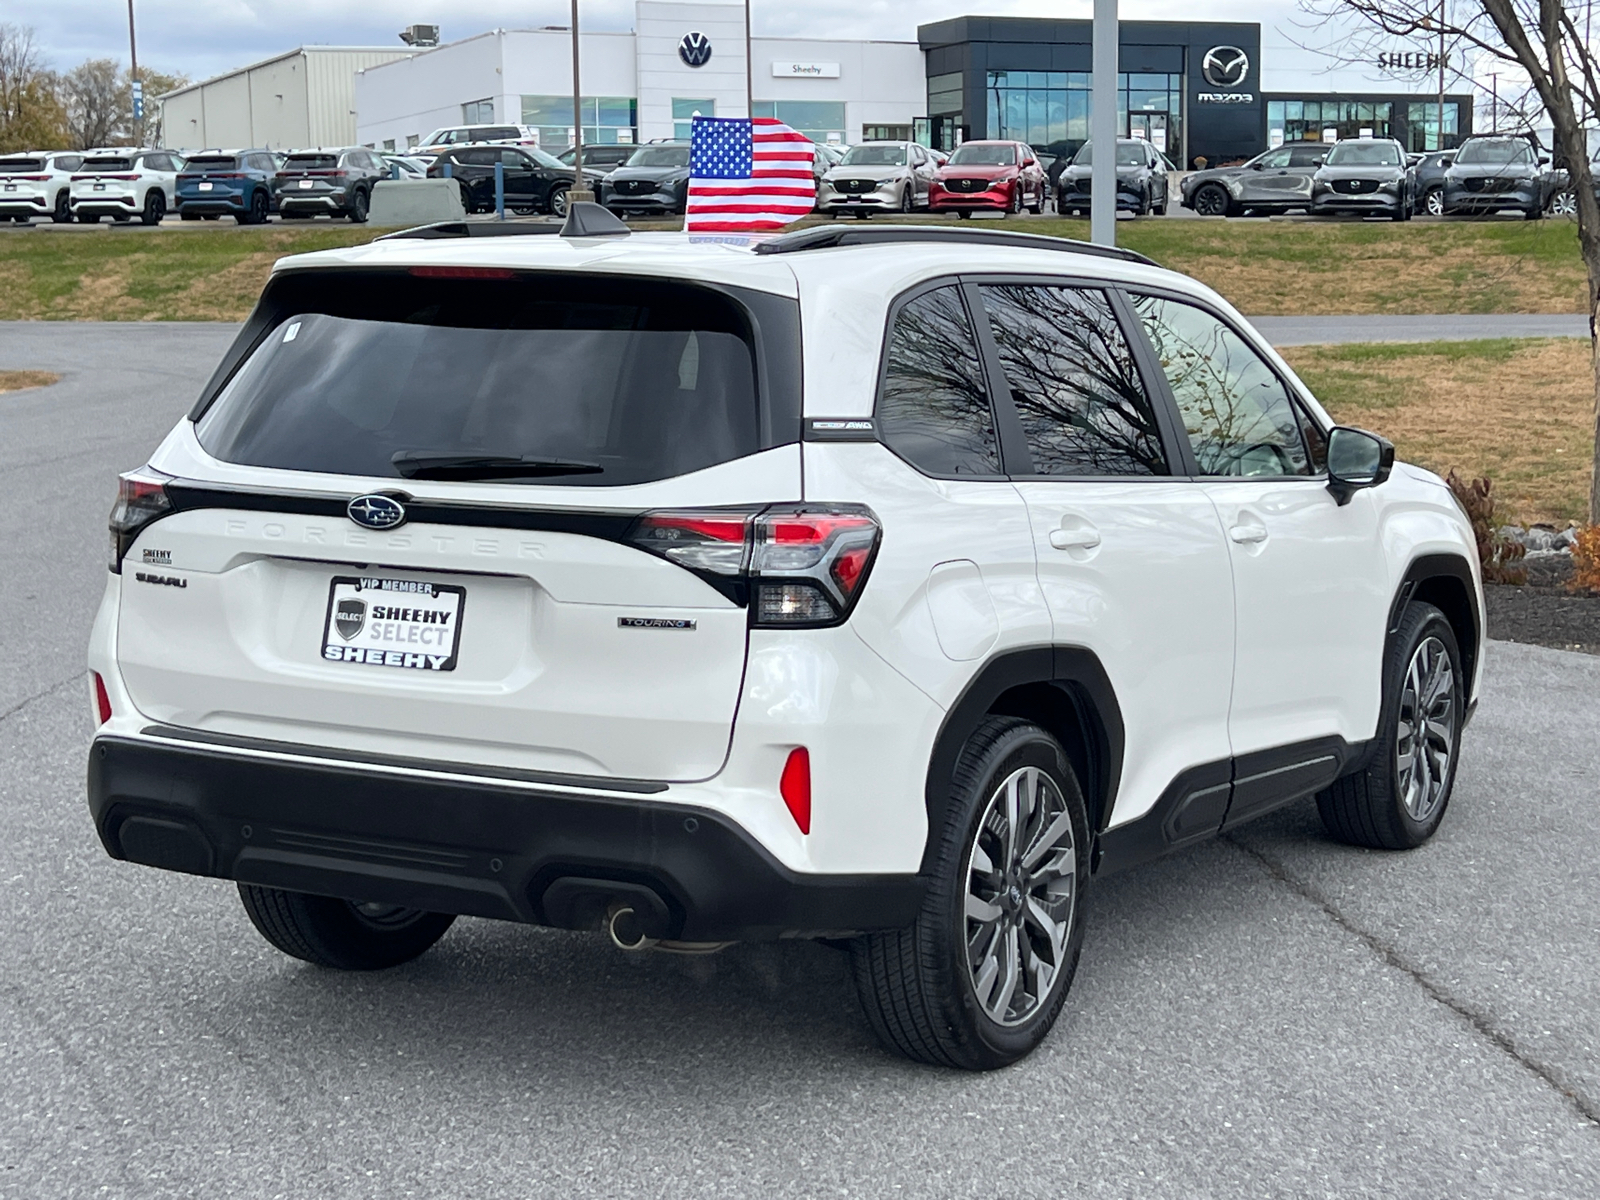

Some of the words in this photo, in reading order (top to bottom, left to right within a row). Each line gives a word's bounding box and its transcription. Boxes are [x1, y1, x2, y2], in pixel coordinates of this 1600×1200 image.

[1377, 51, 1452, 69] SHEEHY
[792, 64, 822, 75] Sheehy
[224, 519, 547, 560] FORESTER
[136, 572, 187, 588] SUBARU
[359, 577, 380, 590] VIP
[381, 580, 433, 594] MEMBER
[336, 612, 364, 622] SELECT
[372, 606, 452, 624] SHEEHY
[626, 618, 685, 628] TOURING
[370, 622, 449, 646] SELECT
[325, 645, 449, 670] SHEEHY
